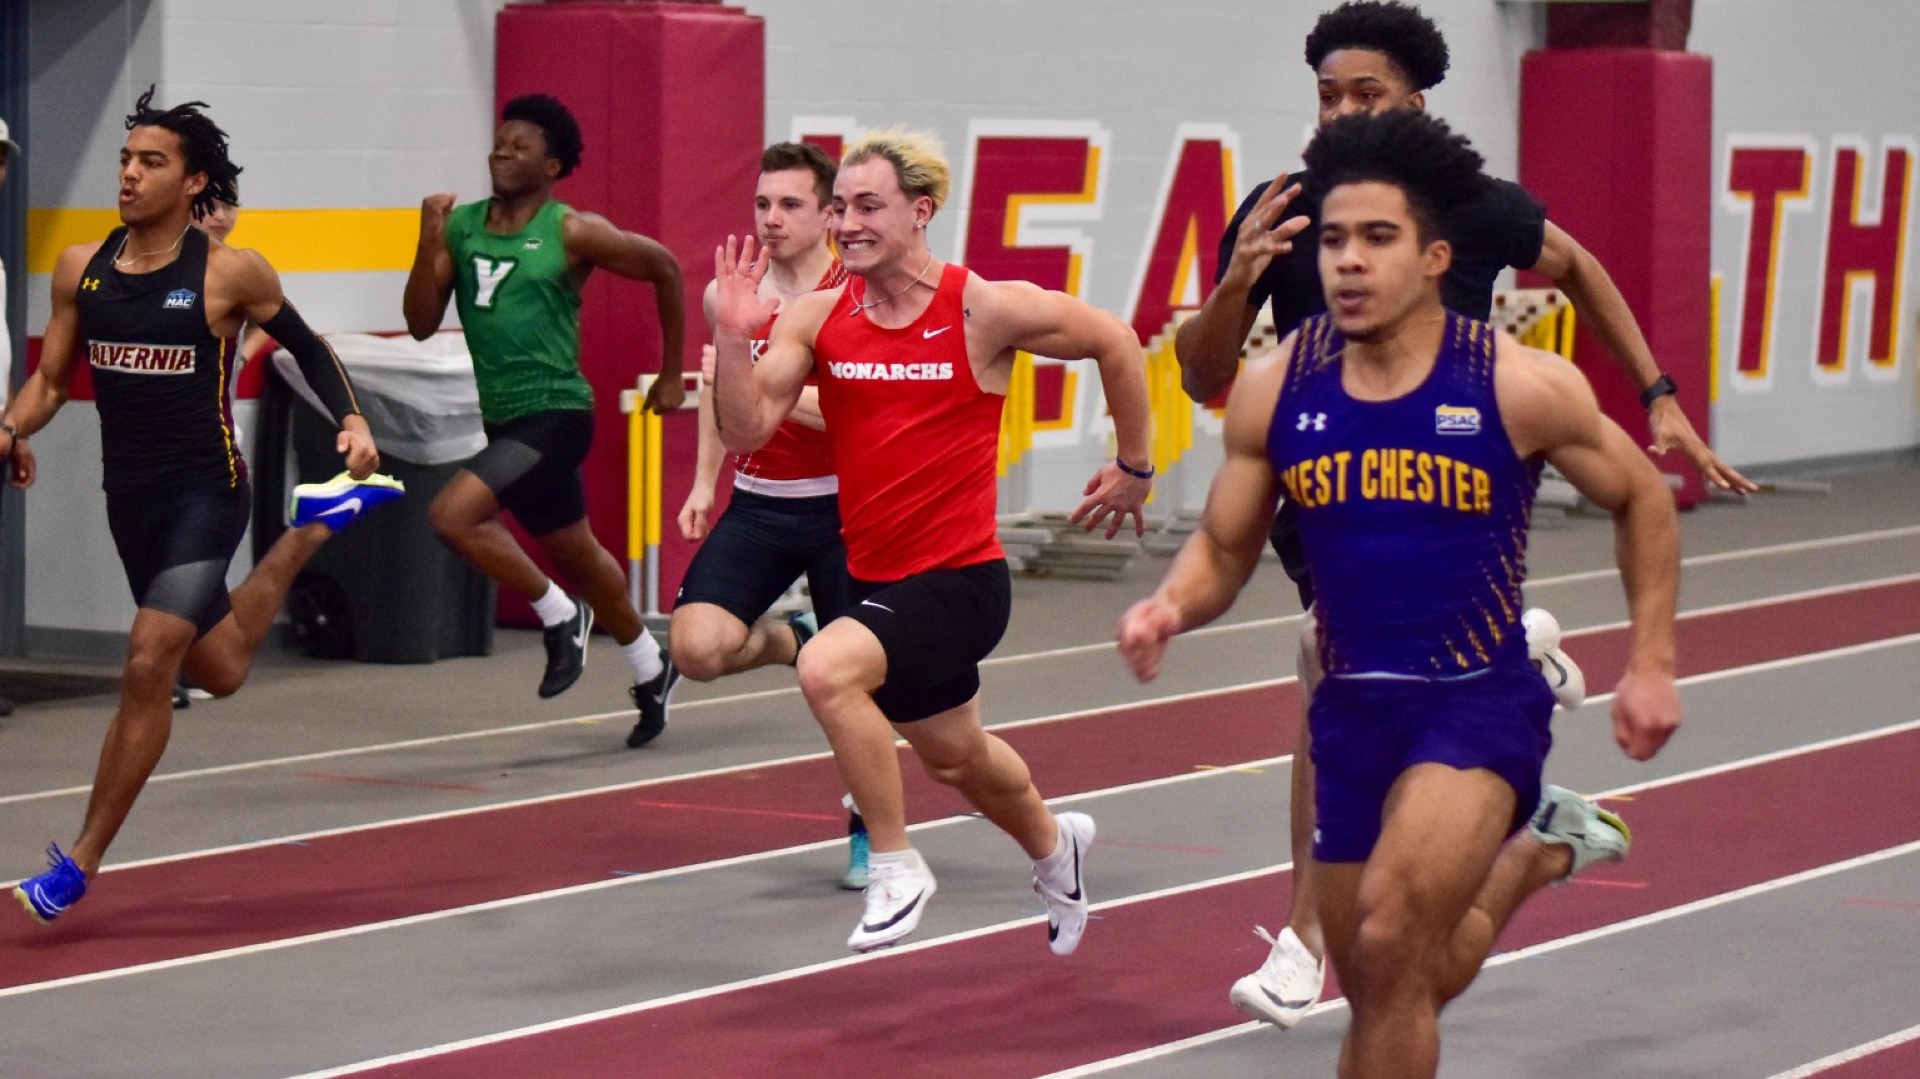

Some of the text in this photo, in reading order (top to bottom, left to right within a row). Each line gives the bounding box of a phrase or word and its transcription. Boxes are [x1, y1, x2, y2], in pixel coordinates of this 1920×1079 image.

[471, 254, 517, 308] Y
[165, 297, 192, 307] MAC
[828, 360, 954, 381] MONARCHS
[1437, 414, 1477, 426] PSAC
[1361, 448, 1491, 514] CHESTER
